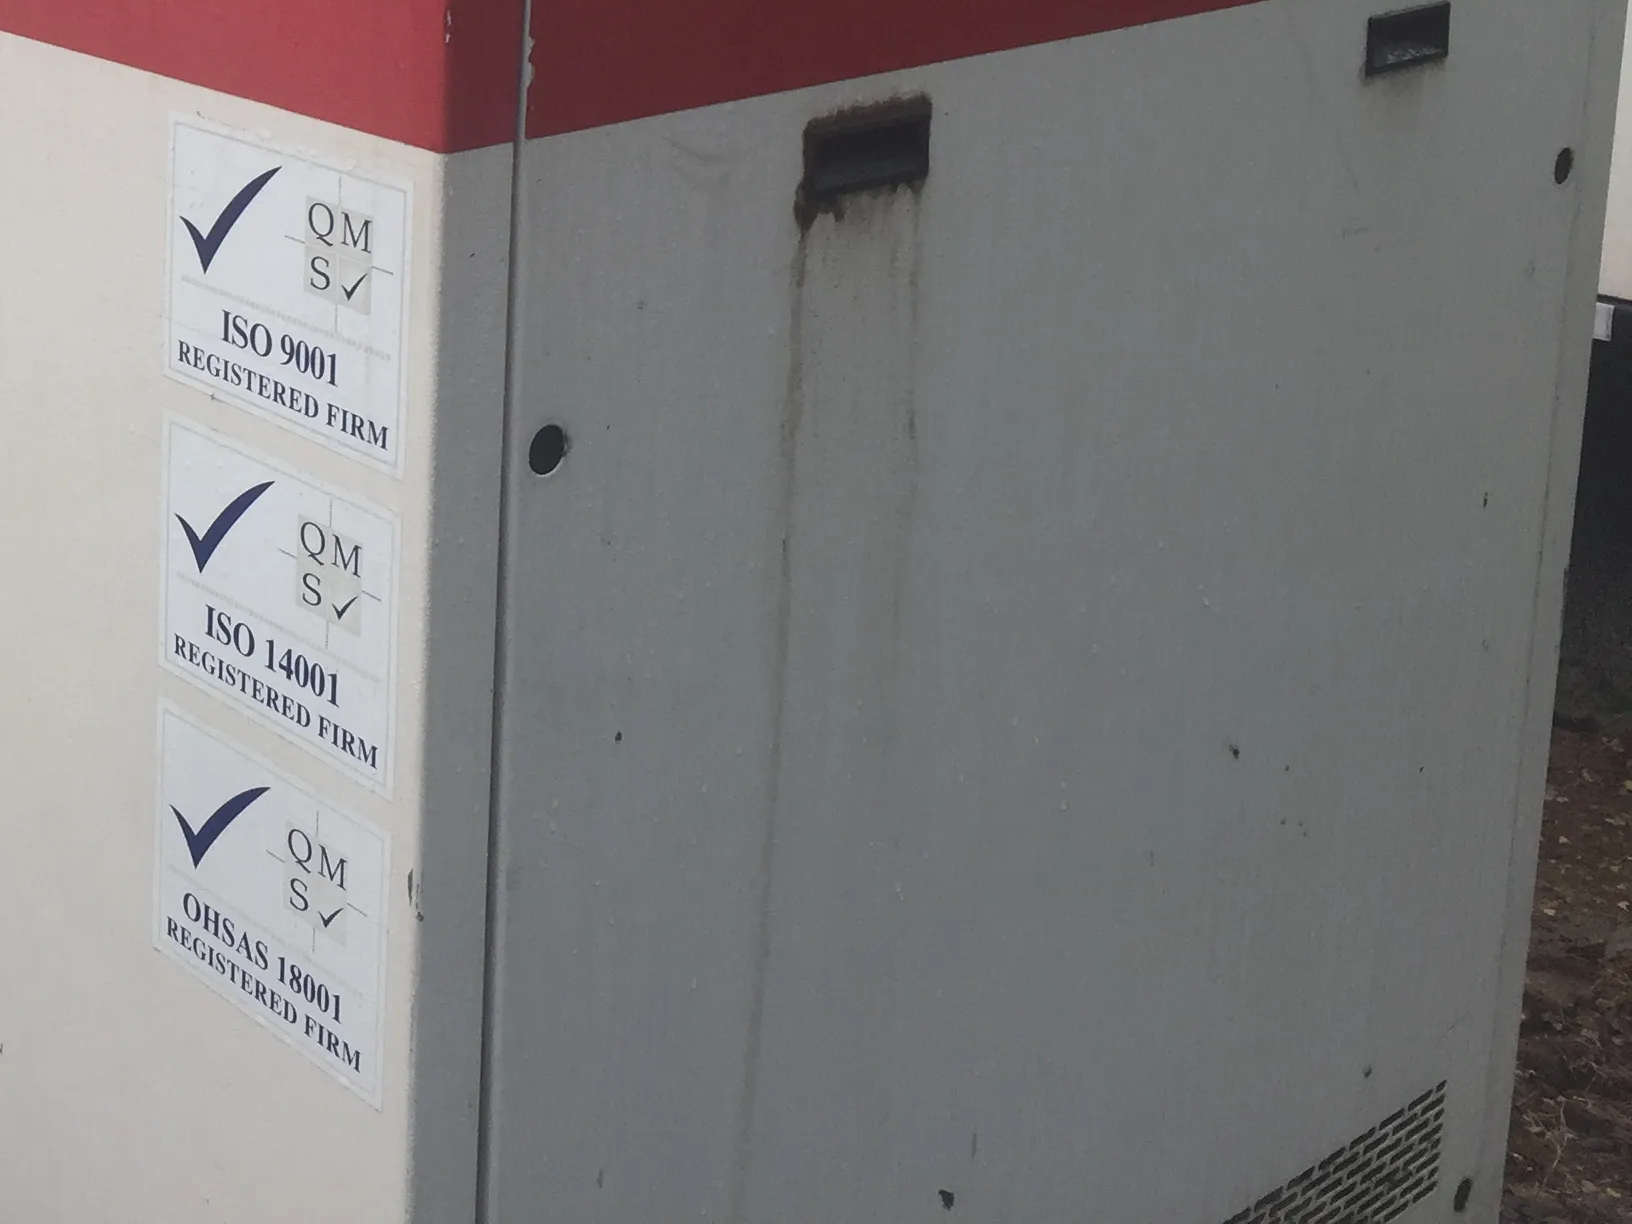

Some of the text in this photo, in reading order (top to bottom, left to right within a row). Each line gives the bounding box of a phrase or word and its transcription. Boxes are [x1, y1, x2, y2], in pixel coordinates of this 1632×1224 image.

[177, 339, 388, 451] REGISTERED FIRM
[221, 309, 338, 387] ISO 9001
[174, 633, 379, 770] REGISTERED FIRM
[205, 603, 340, 708] ISO 14001
[166, 916, 361, 1074] REGISTERED FIRM
[182, 892, 342, 1024] OHSAS 18001
